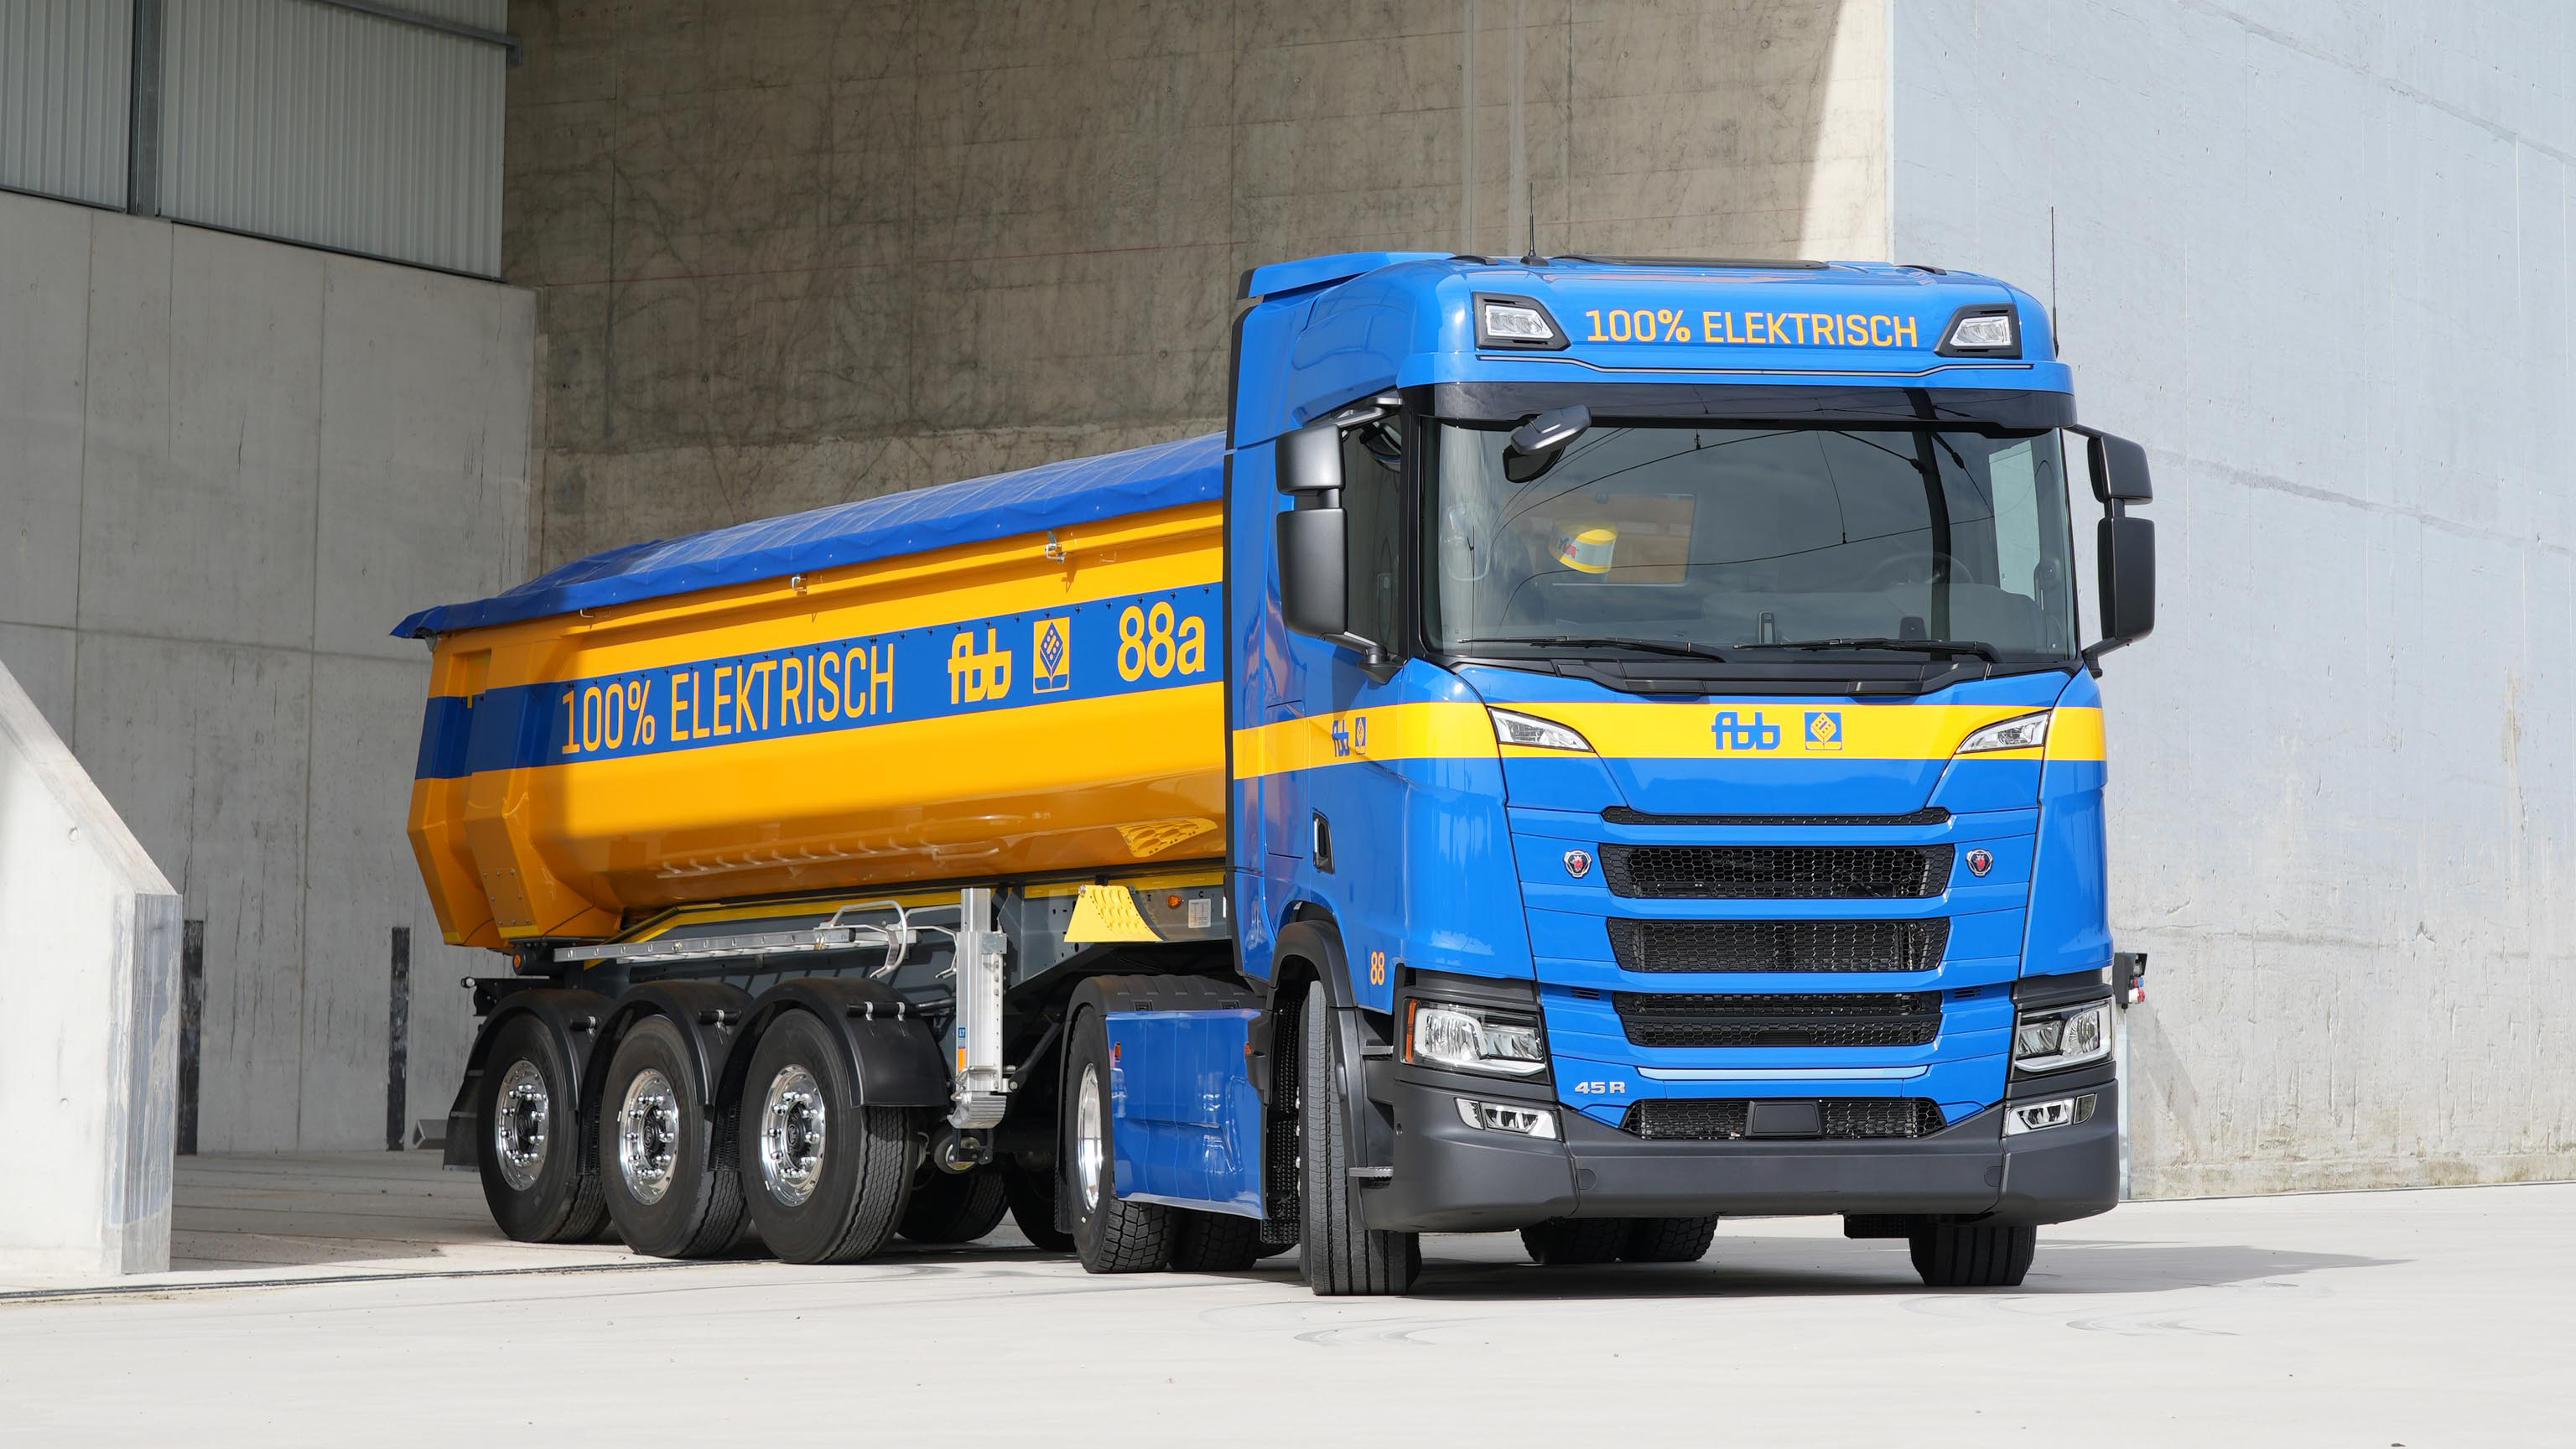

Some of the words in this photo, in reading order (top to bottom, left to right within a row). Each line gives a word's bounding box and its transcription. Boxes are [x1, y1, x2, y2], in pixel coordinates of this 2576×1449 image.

[1585, 309, 1691, 342] 100%
[1702, 310, 1919, 348] ELEKTRISCH
[1117, 600, 1206, 682] 88a
[947, 627, 1012, 704] fbb
[561, 679, 656, 756] 100%
[670, 642, 895, 742] ELEKTRISCH
[1711, 711, 1781, 750] fbb
[1369, 950, 1385, 985] 88
[1574, 1081, 1606, 1094] 45
[1608, 1081, 1626, 1094] R
